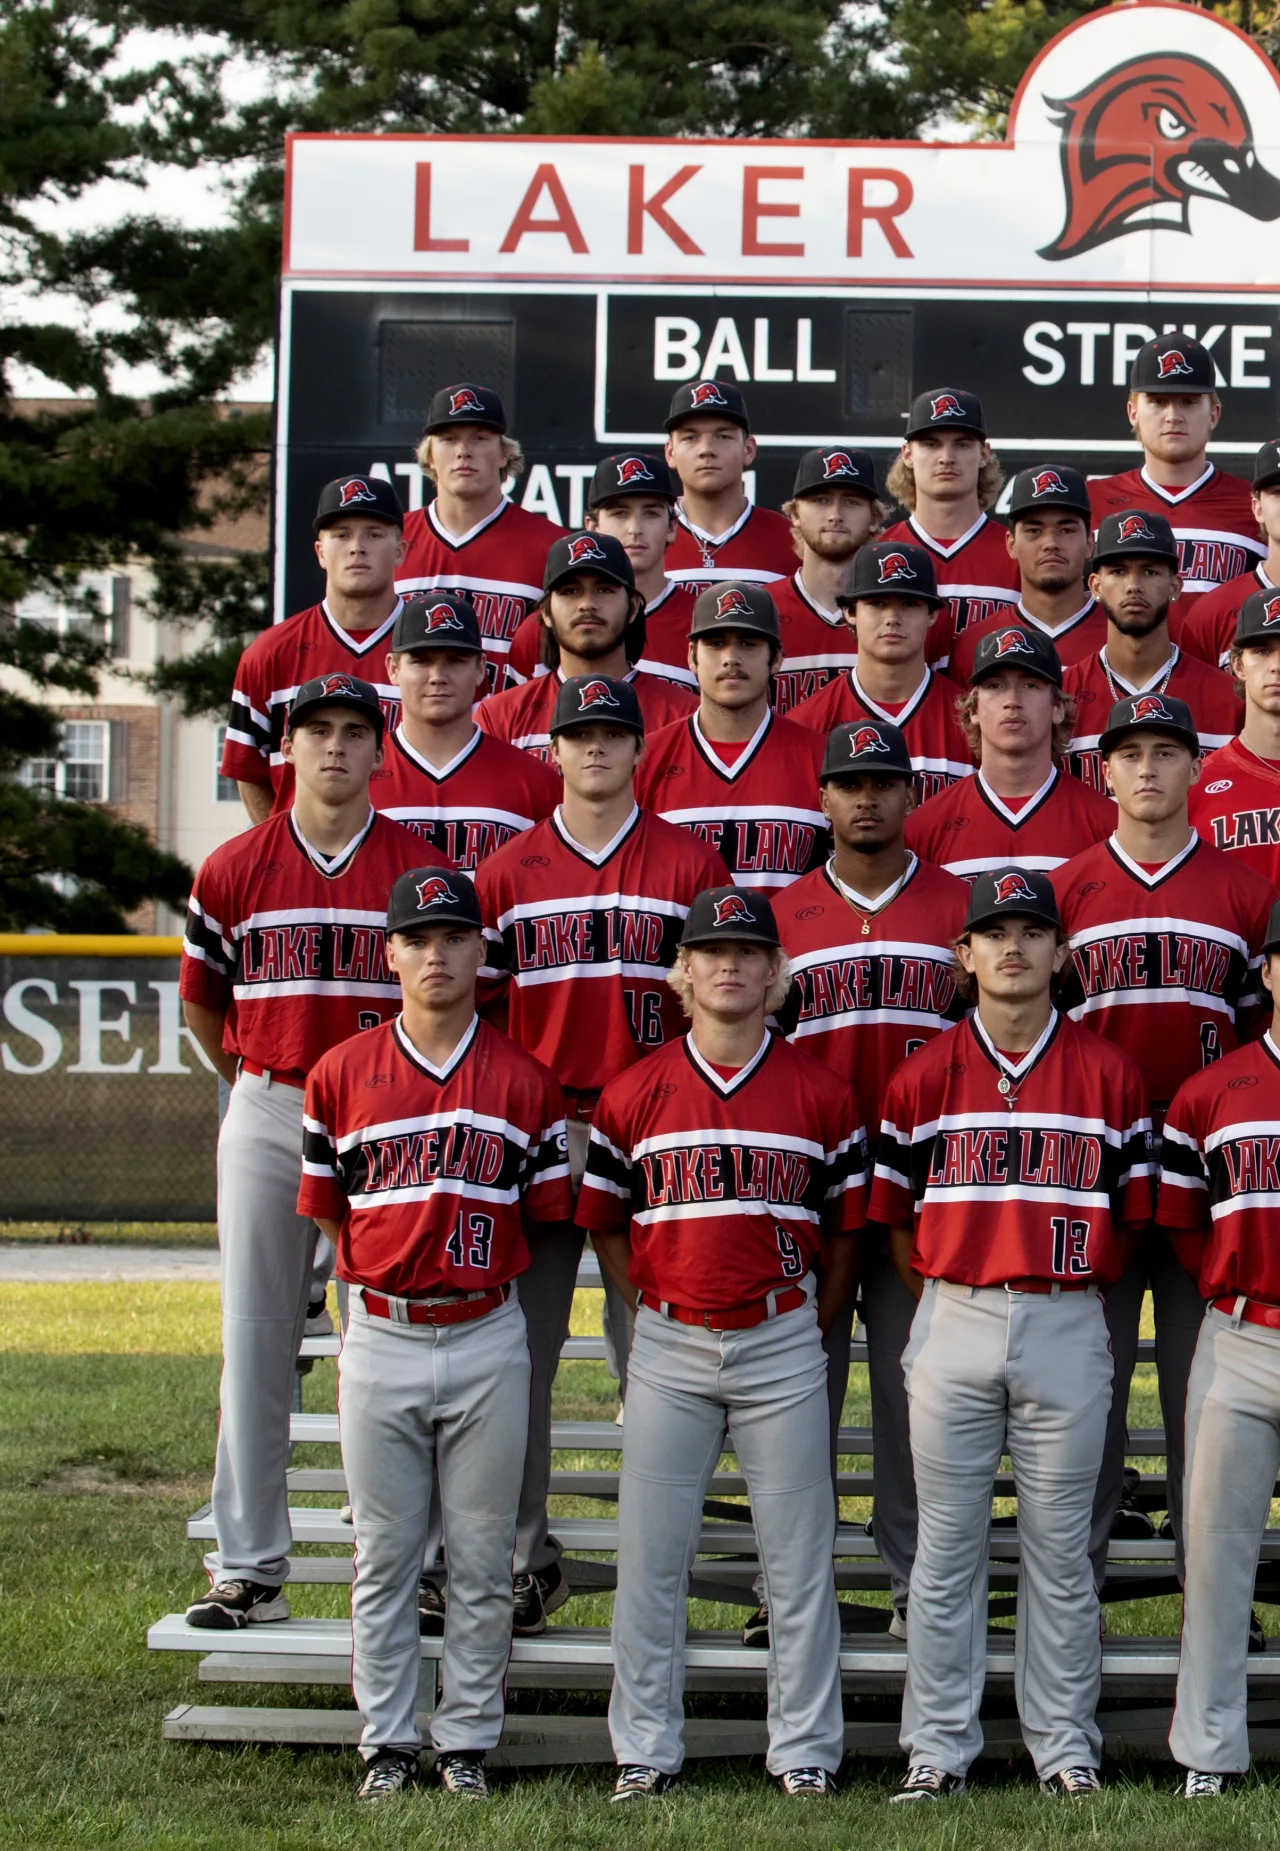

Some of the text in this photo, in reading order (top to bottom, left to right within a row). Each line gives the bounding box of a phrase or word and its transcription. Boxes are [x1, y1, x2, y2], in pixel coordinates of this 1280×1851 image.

[412, 160, 915, 259] LAKER
[653, 316, 837, 384] BALL
[1021, 320, 1272, 389] STRKE
[454, 590, 527, 640] AND
[771, 669, 829, 716] AKE
[444, 821, 520, 869] LAN
[735, 821, 817, 872] LAND
[243, 926, 400, 983] LAKE LAN
[514, 909, 665, 970] LAKE LND
[1072, 934, 1232, 999] LAKE LAND
[795, 956, 957, 1021] LAKE LAND
[361, 1130, 440, 1193] LAKE
[443, 1125, 506, 1186] LND
[640, 1146, 725, 1208] LAKE
[730, 1145, 812, 1204] LAND
[925, 1129, 1103, 1190] LAKE LAND
[445, 1210, 495, 1270] 43
[774, 1224, 804, 1278] 9
[1049, 1216, 1094, 1275] 13
